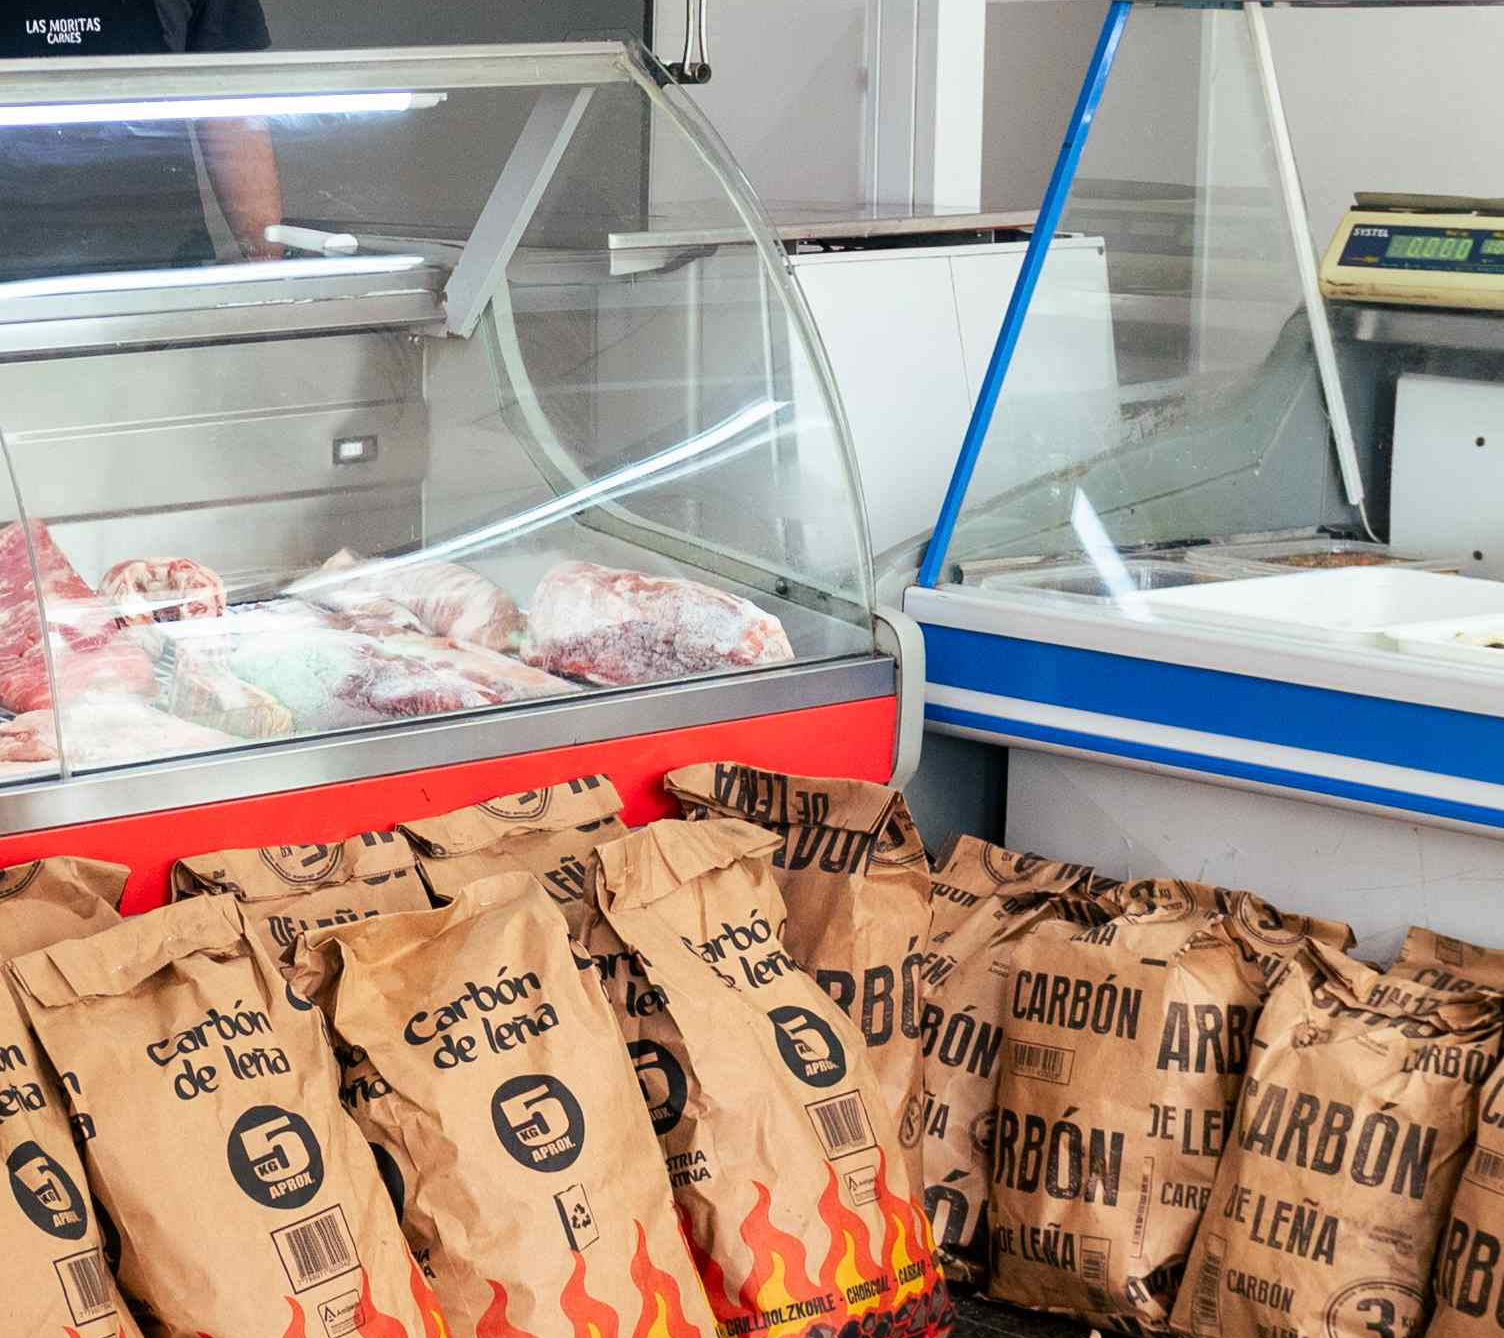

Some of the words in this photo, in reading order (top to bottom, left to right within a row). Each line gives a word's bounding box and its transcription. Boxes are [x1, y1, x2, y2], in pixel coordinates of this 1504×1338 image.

[26, 19, 46, 35] LAS
[49, 17, 101, 33] MORITAS
[47, 31, 82, 45] CARNES
[404, 966, 544, 1046] Carbón
[1012, 973, 1143, 1040] CARBÓN
[433, 1034, 478, 1071] de
[484, 1001, 560, 1053] leña
[779, 1014, 831, 1062] 5
[175, 1061, 220, 1101] de
[226, 1045, 290, 1081] leña
[497, 1084, 573, 1144] 5
[517, 1126, 540, 1144] KG
[1239, 1079, 1438, 1200] ARBÓN
[240, 1115, 311, 1182] 5
[530, 1138, 577, 1166] APROX.
[14, 1155, 72, 1212] 5
[1020, 1221, 1077, 1273] LEÑA
[1248, 1193, 1339, 1265] LEÑA
[1226, 1268, 1296, 1314] CARBÓN
